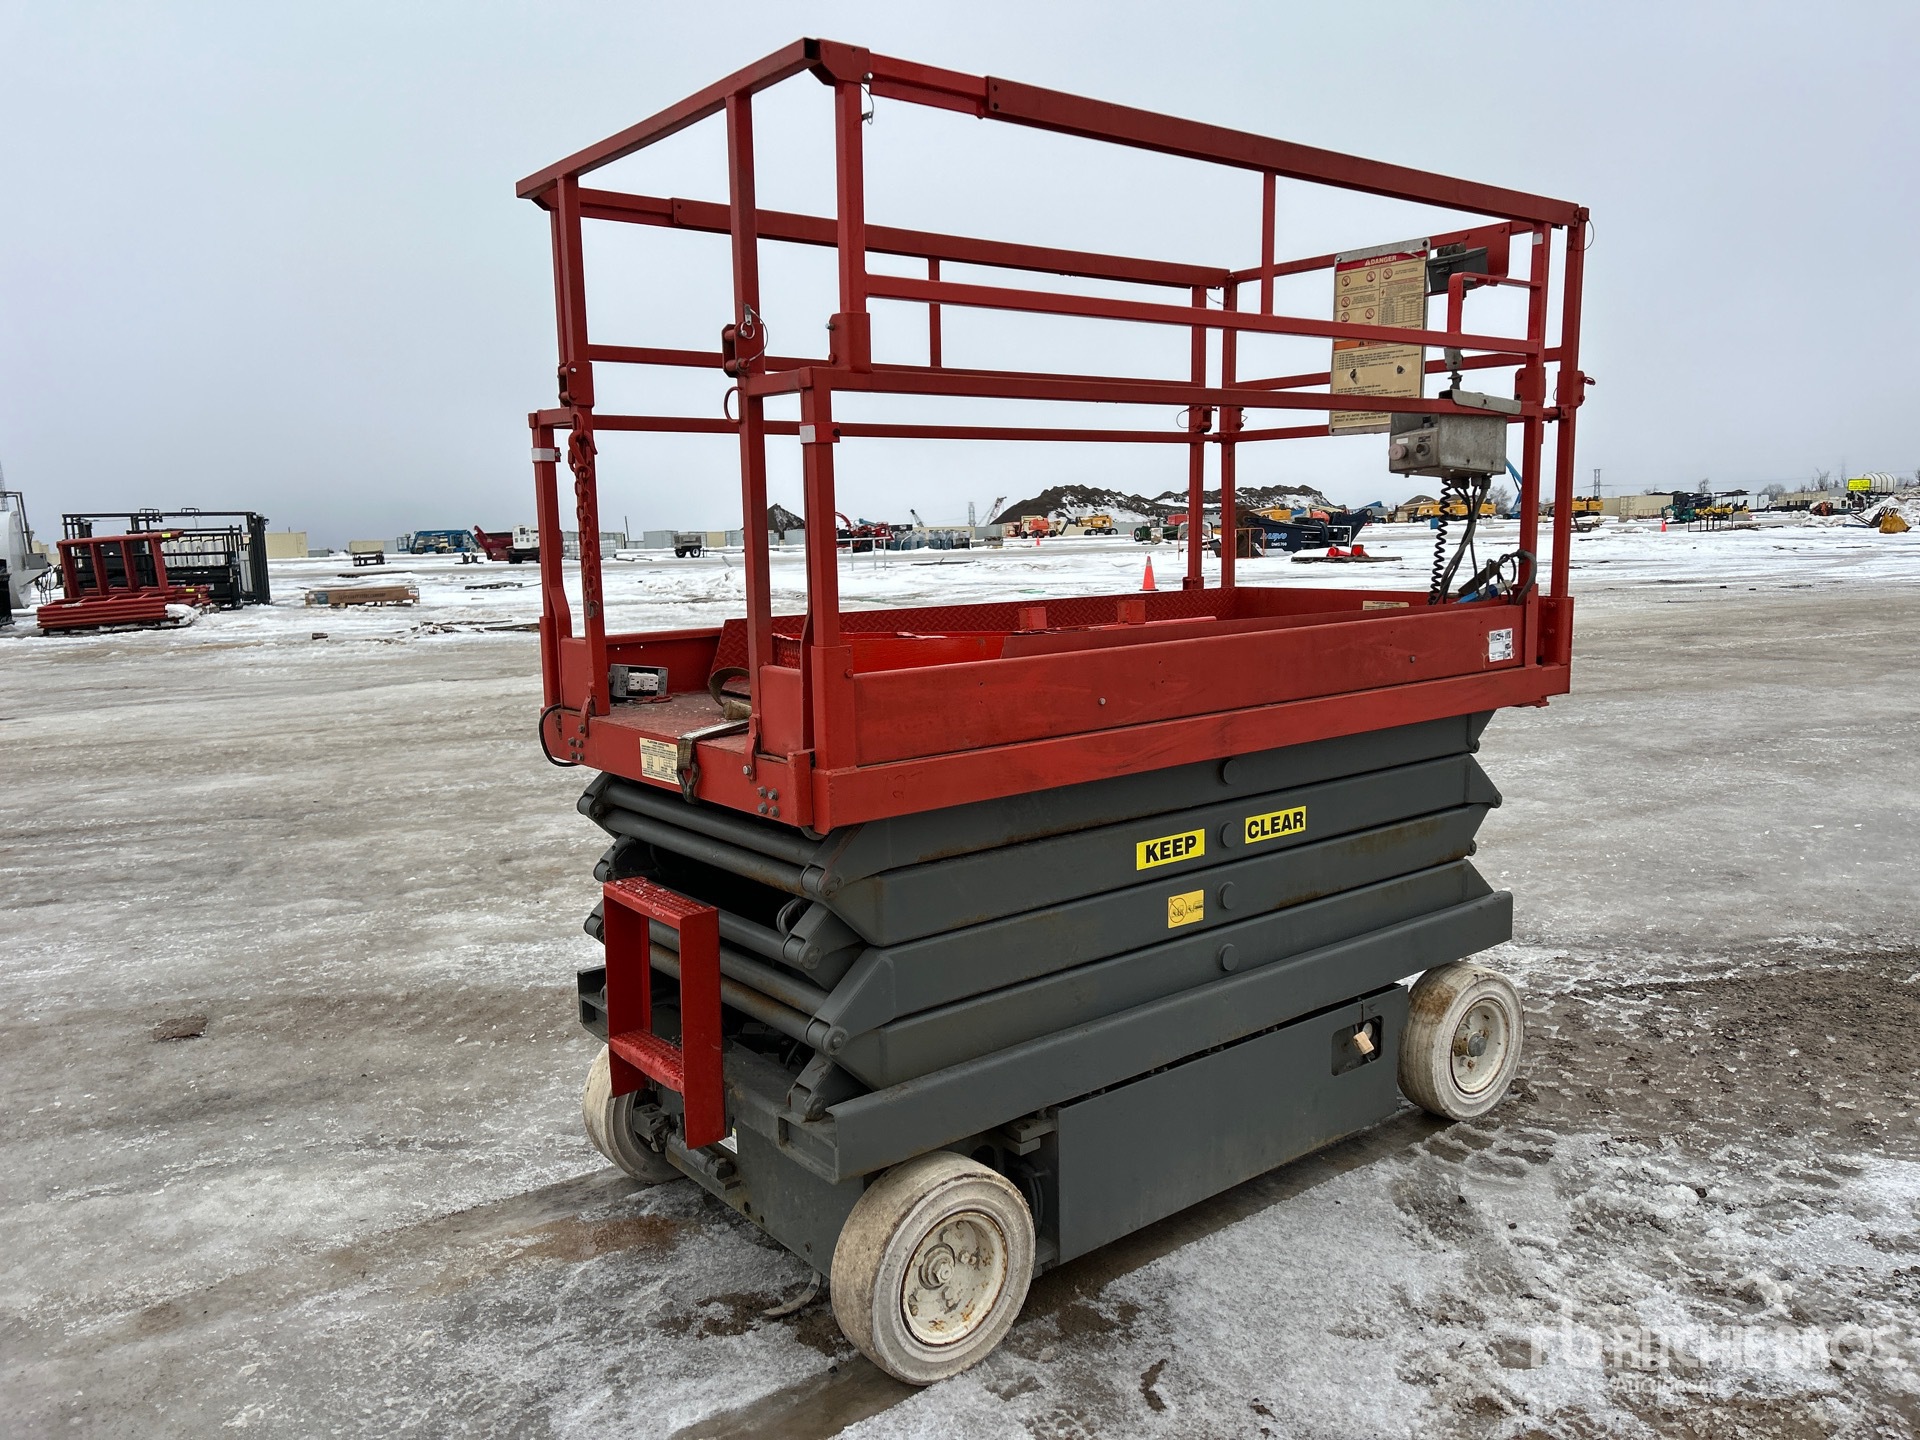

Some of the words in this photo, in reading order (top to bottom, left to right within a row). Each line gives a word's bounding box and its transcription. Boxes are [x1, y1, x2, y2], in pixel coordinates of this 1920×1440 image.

[1370, 255, 1397, 265] DANGER
[1145, 835, 1197, 864] KEEP
[1247, 811, 1304, 839] CLEAR
